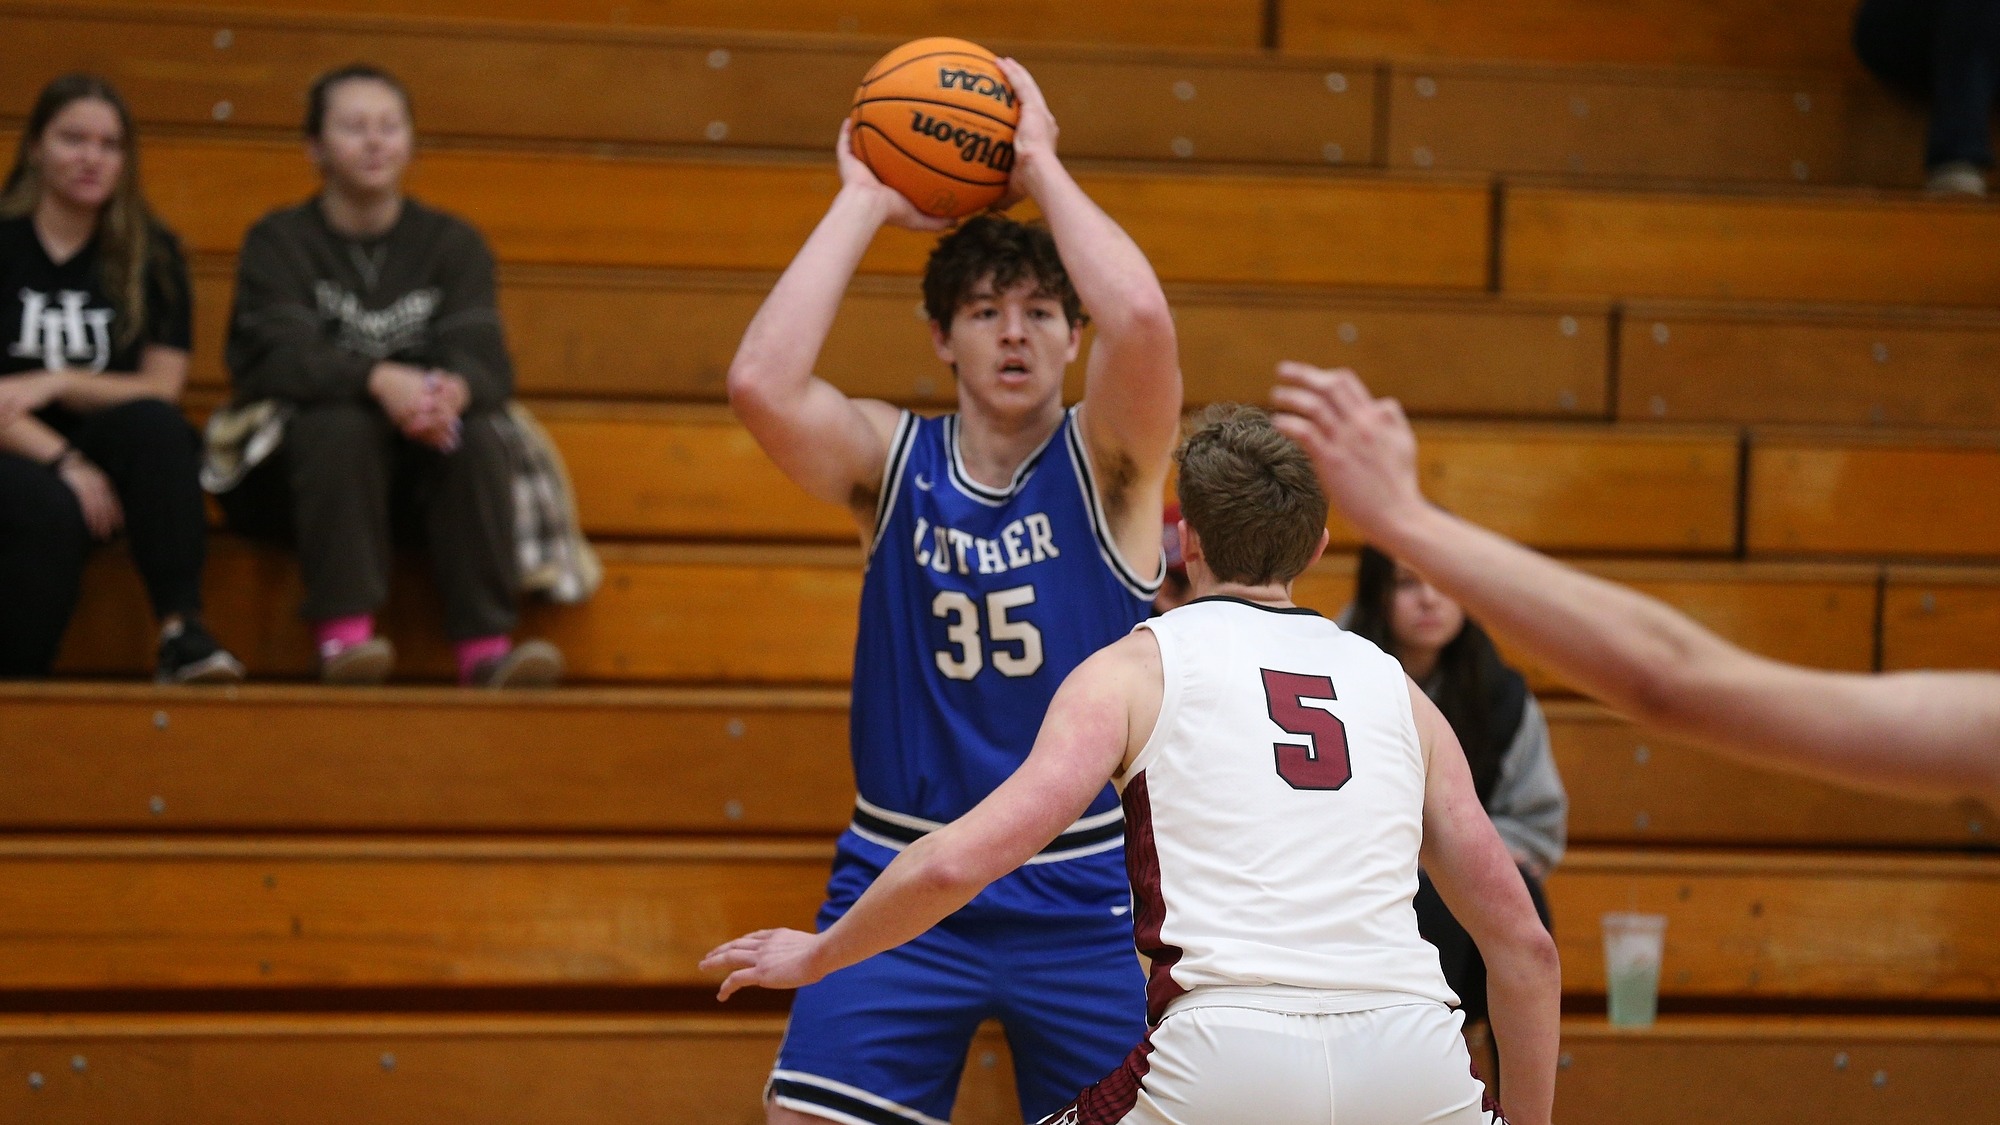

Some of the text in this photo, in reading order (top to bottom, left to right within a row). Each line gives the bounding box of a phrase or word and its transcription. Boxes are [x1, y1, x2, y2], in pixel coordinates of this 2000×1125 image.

[939, 67, 1015, 108] NCAA
[911, 112, 1015, 173] Wilson
[914, 512, 1060, 575] LUTHER
[932, 584, 1044, 681] 35
[1259, 667, 1352, 791] 5
